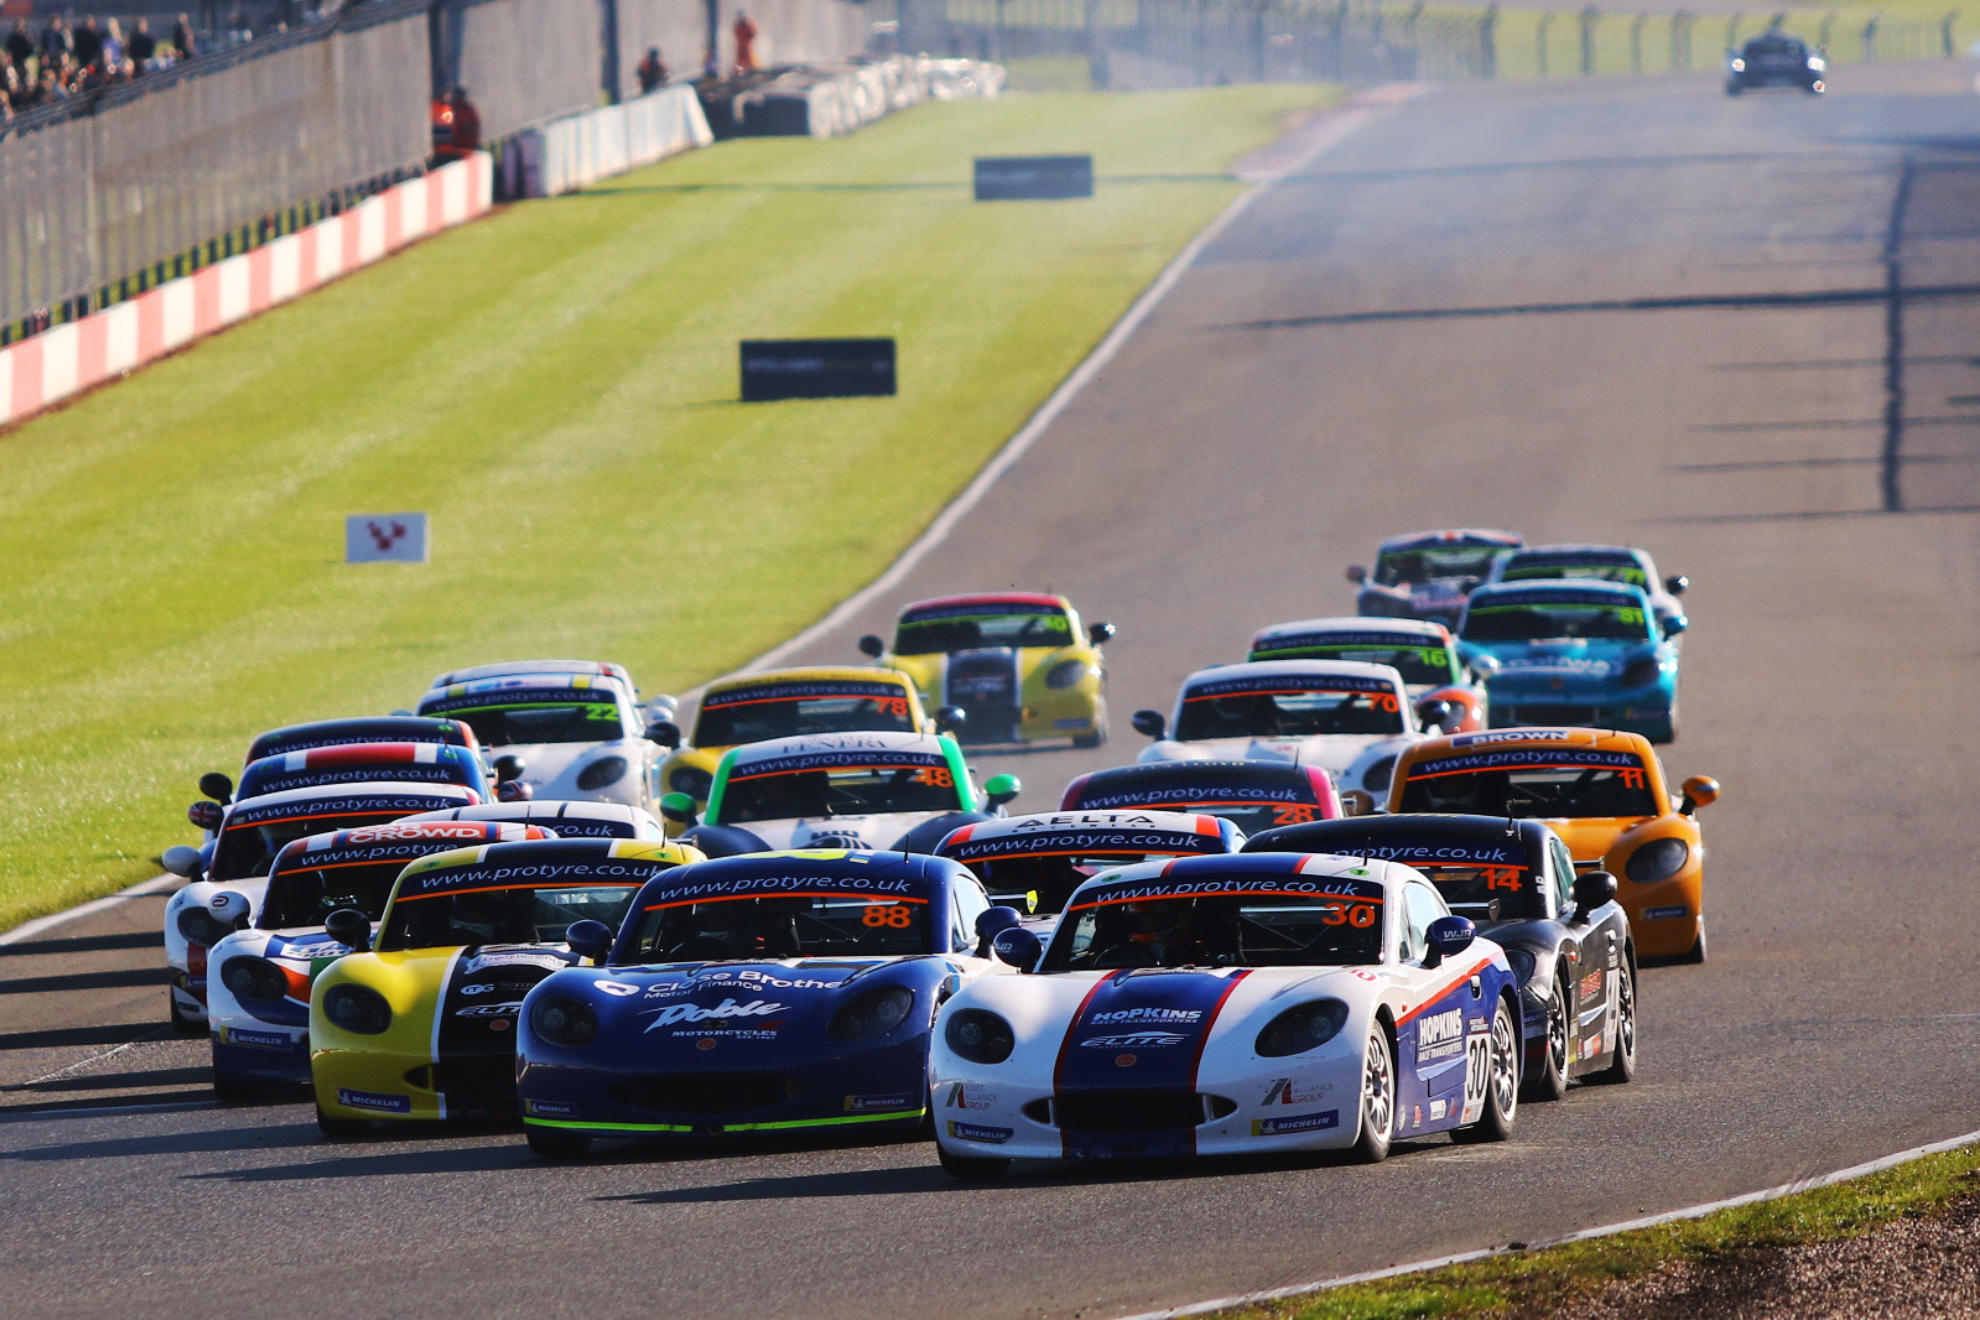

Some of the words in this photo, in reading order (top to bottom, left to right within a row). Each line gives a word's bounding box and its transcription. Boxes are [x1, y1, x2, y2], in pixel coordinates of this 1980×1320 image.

[1418, 650, 1448, 668] 16
[585, 702, 620, 722] 22
[876, 698, 909, 716] 78
[1367, 693, 1400, 713] 70
[1472, 731, 1570, 745] BROWN
[741, 751, 938, 775] www.protyre.co.uk
[1424, 750, 1633, 774] www.protyre.co.uk
[263, 768, 451, 793] www.protyre.co.uk
[915, 768, 954, 788] 48
[1617, 768, 1646, 790] 11
[248, 797, 451, 820] www.protyre.co.uk
[1083, 785, 1298, 810] www.protyre.co.uk
[1272, 805, 1315, 825] 28
[350, 827, 481, 843] CROWD
[959, 832, 1201, 857] www.protyre.co.uk
[423, 862, 662, 889] www.protyre.co.uk
[1480, 868, 1523, 892] 14
[660, 874, 912, 901] www.protyre.co.uk
[1096, 878, 1360, 904] www.protyre.co.uk
[861, 905, 912, 929] 88
[1322, 902, 1376, 929] 30
[643, 987, 693, 999] Motor
[698, 981, 764, 993] Finance
[647, 971, 733, 994] Close
[1093, 1007, 1203, 1021] HOPKINS
[671, 1029, 778, 1037] MOTORCYCLES
[1419, 1007, 1463, 1046] HOPKINS
[237, 1033, 283, 1045] MICHELIN
[1466, 1038, 1489, 1101] 30
[352, 1095, 401, 1108] MICHELIN
[1277, 1116, 1330, 1130] MICHELIN
